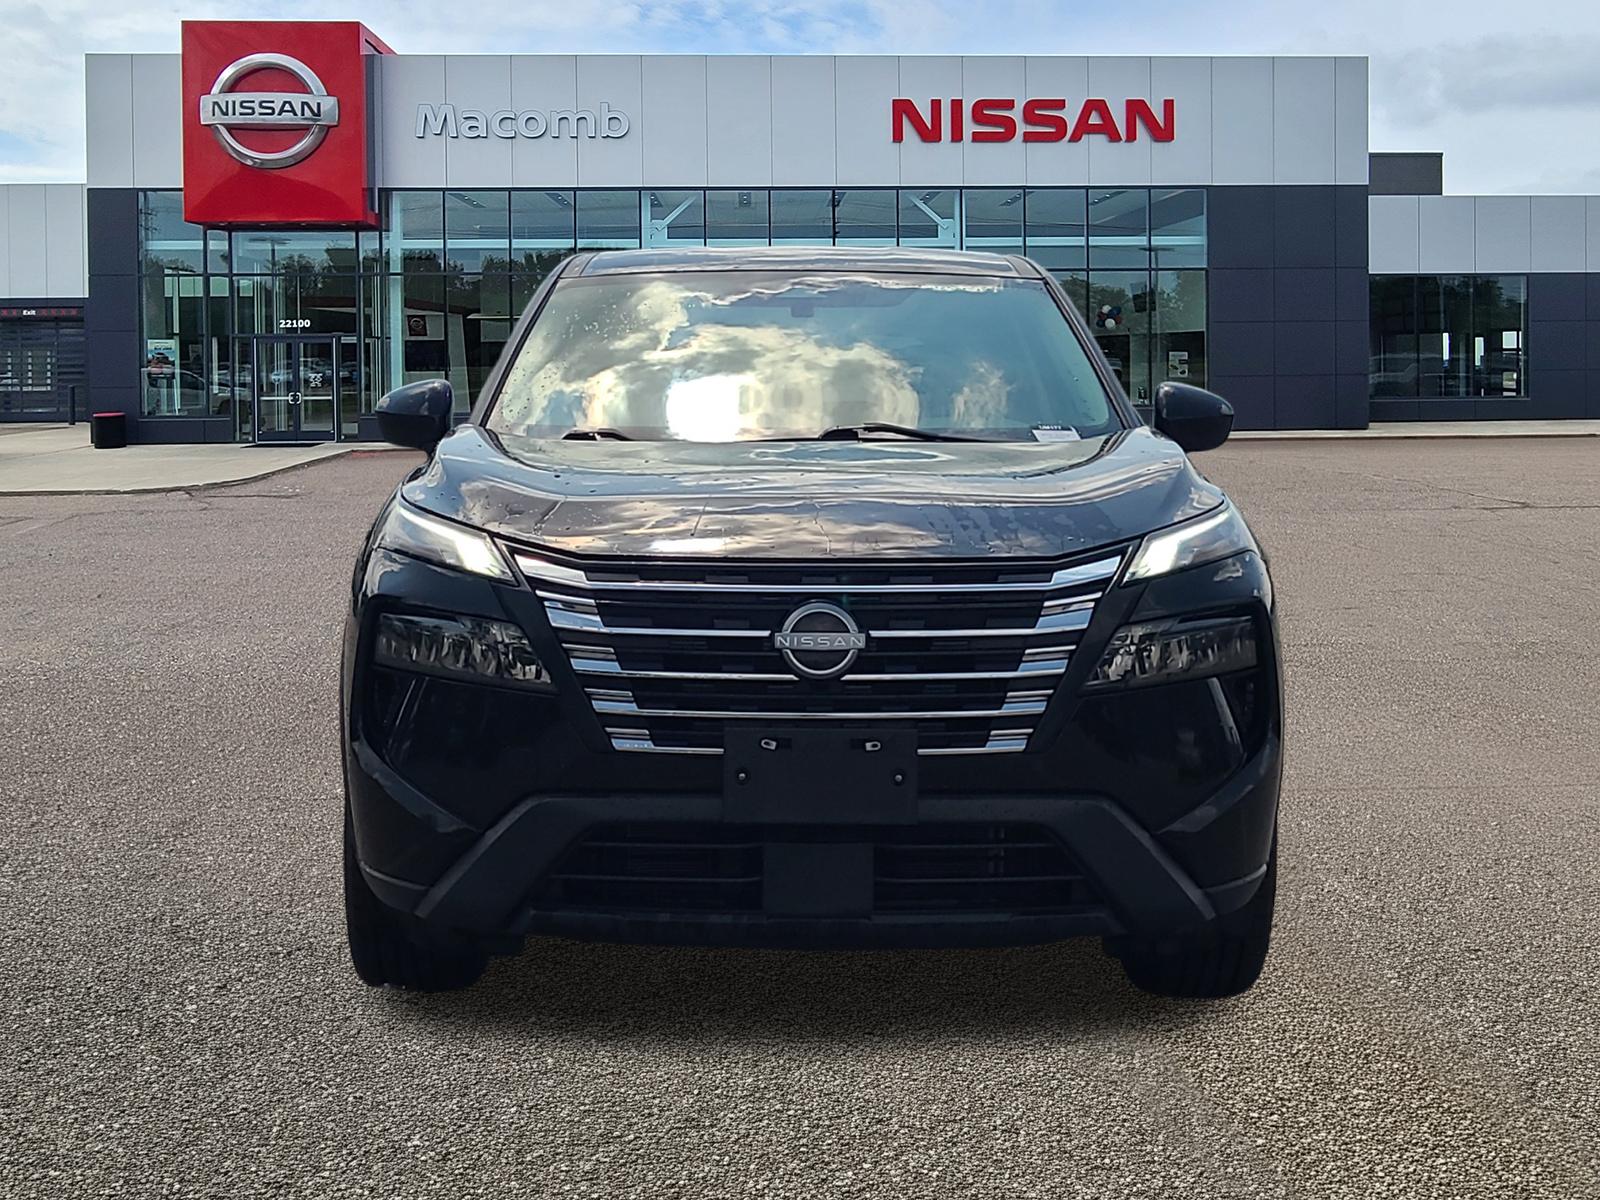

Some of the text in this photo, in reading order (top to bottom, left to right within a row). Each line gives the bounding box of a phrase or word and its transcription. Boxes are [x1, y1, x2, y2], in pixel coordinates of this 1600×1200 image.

[212, 100, 322, 117] NISSAN
[415, 101, 630, 139] Macomb
[892, 98, 1175, 142] NISSAN
[279, 319, 311, 328] 22100
[777, 636, 863, 647] NISSAN
